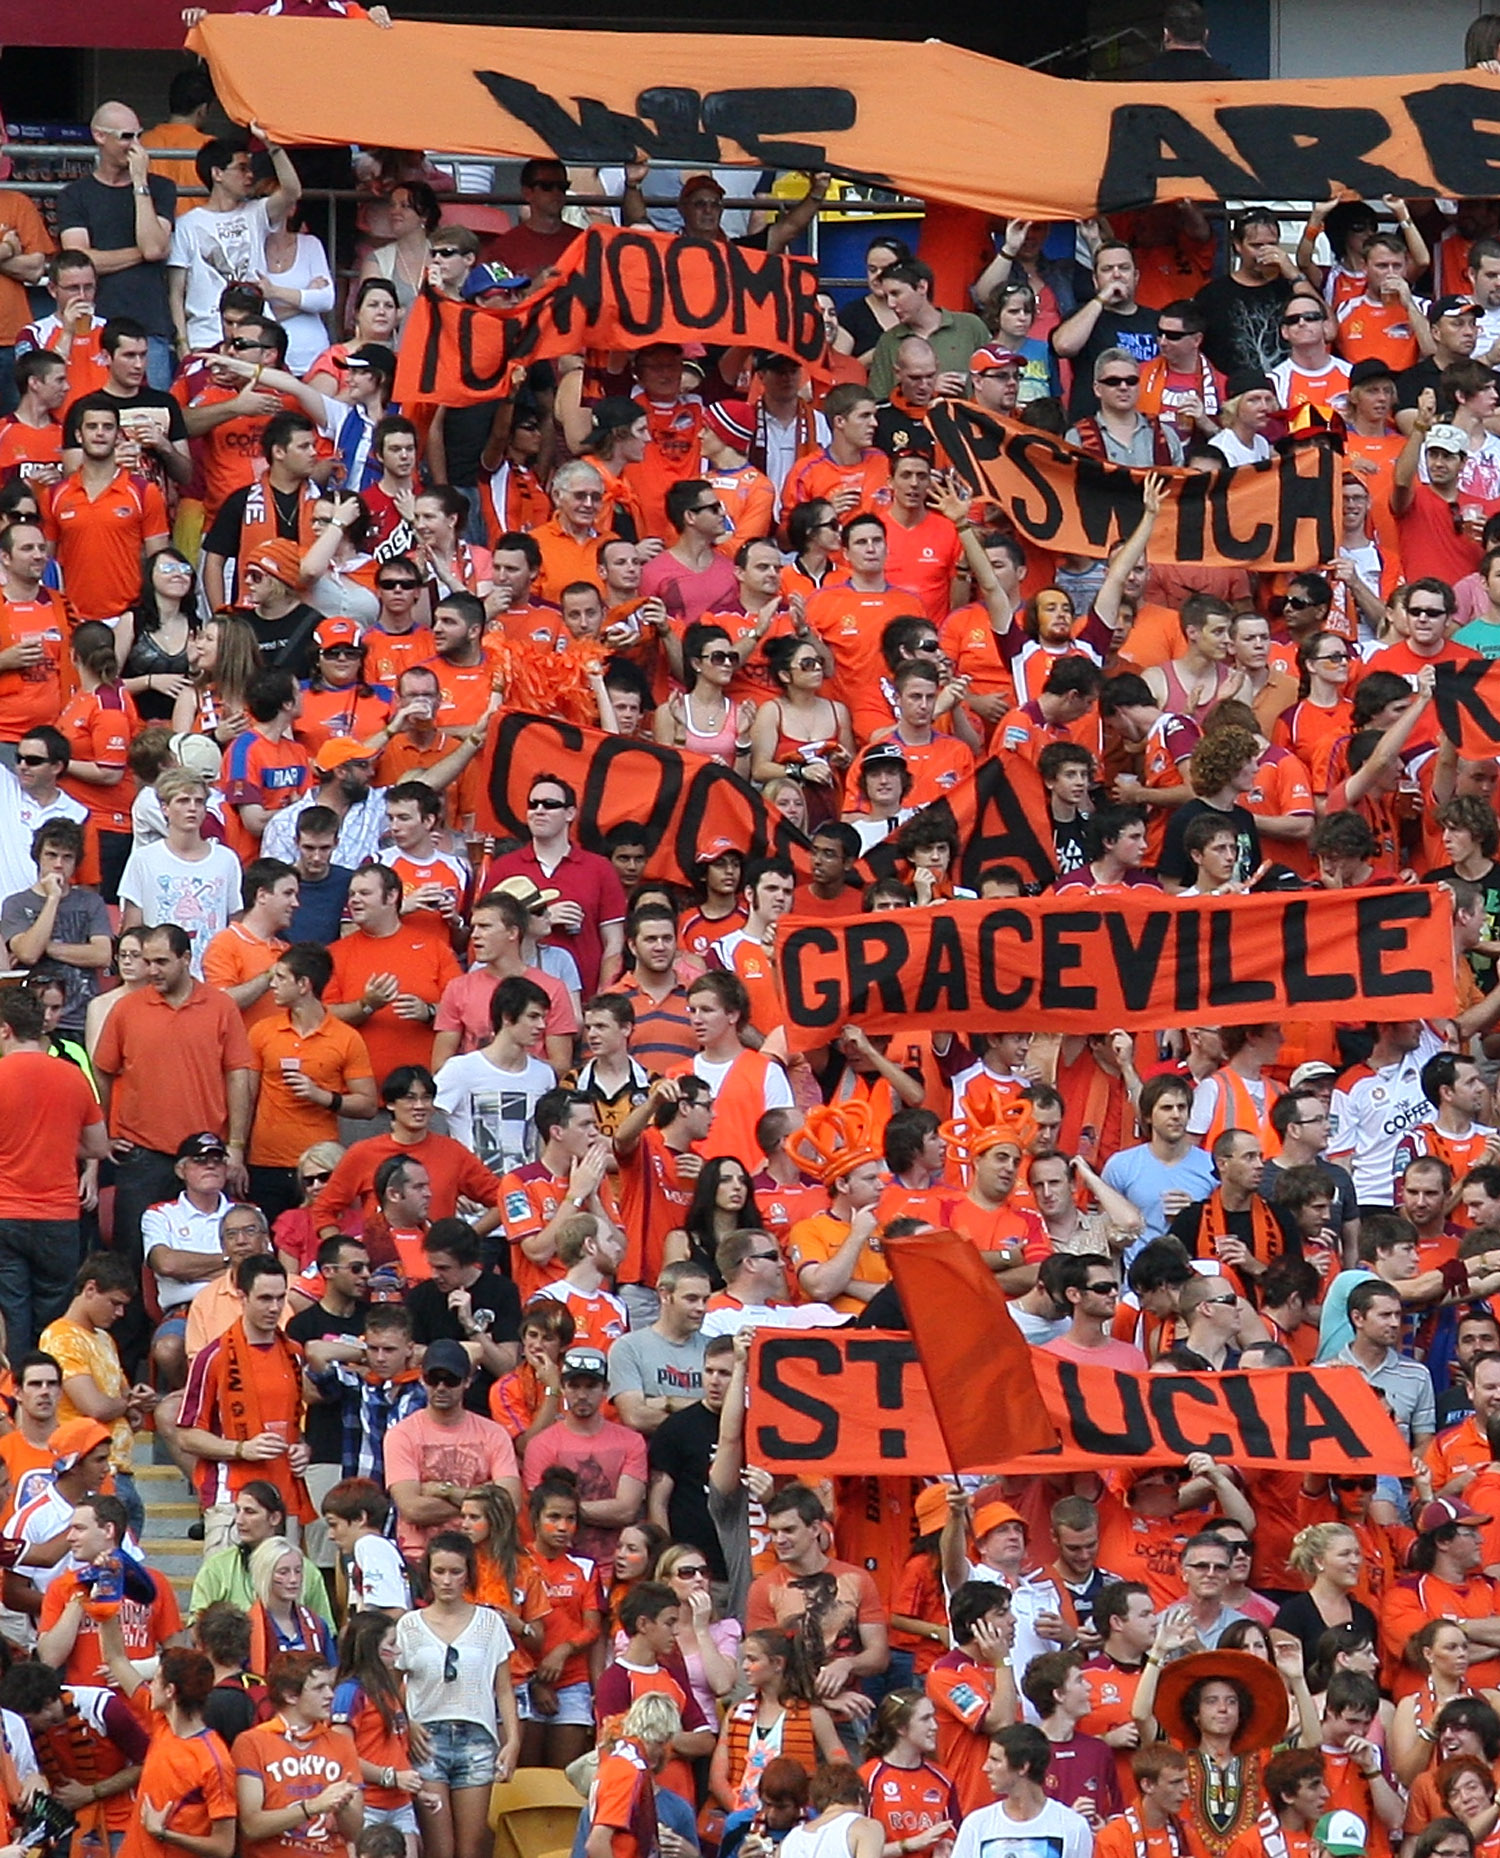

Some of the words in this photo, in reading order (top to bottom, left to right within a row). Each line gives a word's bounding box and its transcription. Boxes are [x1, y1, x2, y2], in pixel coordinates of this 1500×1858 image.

[474, 70, 893, 182] WE
[931, 403, 1343, 563] IPSWICH
[782, 891, 1433, 1028] GRACEVILLE
[1384, 1099, 1433, 1135] COFFEE
[1032, 1362, 1369, 1459] UCIA
[266, 1755, 343, 1784] TOKYO
[306, 1813, 329, 1839] 2
